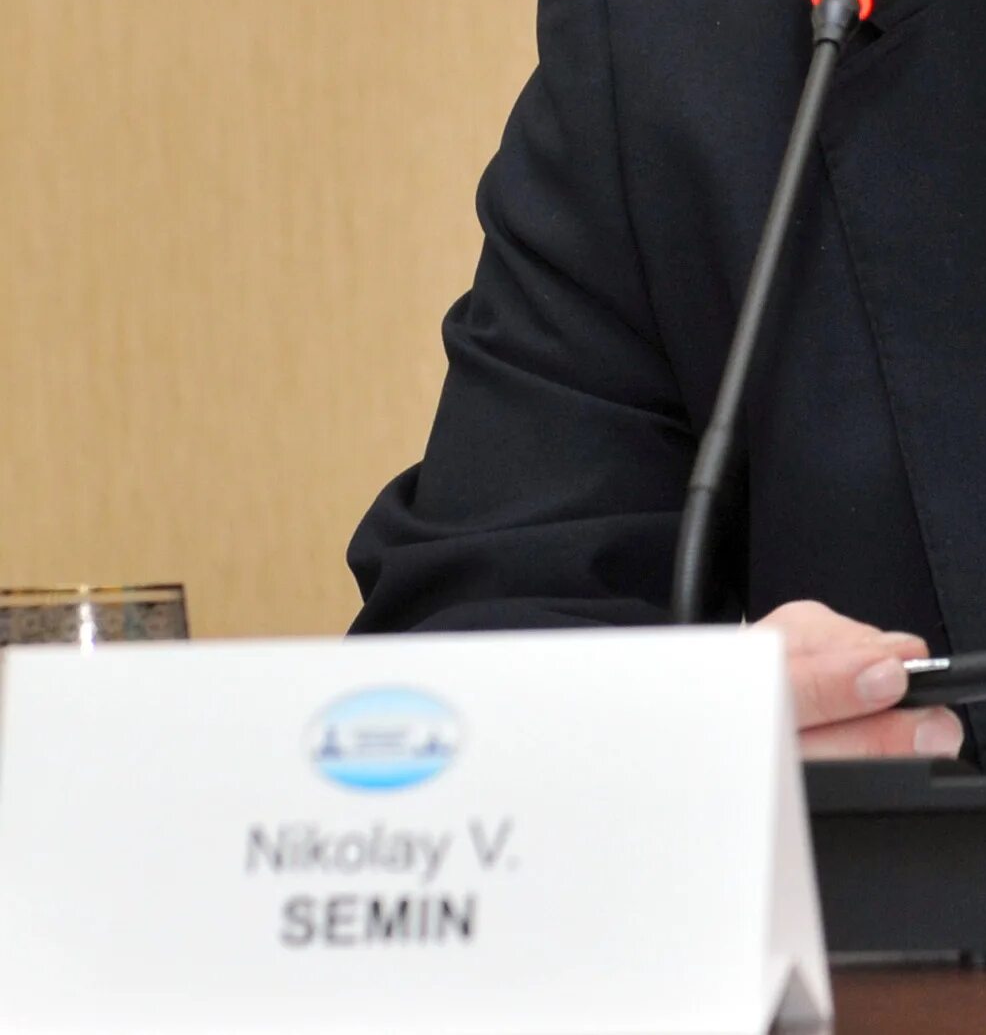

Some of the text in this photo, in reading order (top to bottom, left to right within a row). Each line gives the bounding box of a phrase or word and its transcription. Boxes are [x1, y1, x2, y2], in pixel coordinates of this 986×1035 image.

[247, 816, 520, 884] Nikolay V.
[279, 892, 477, 949] SEMIN
